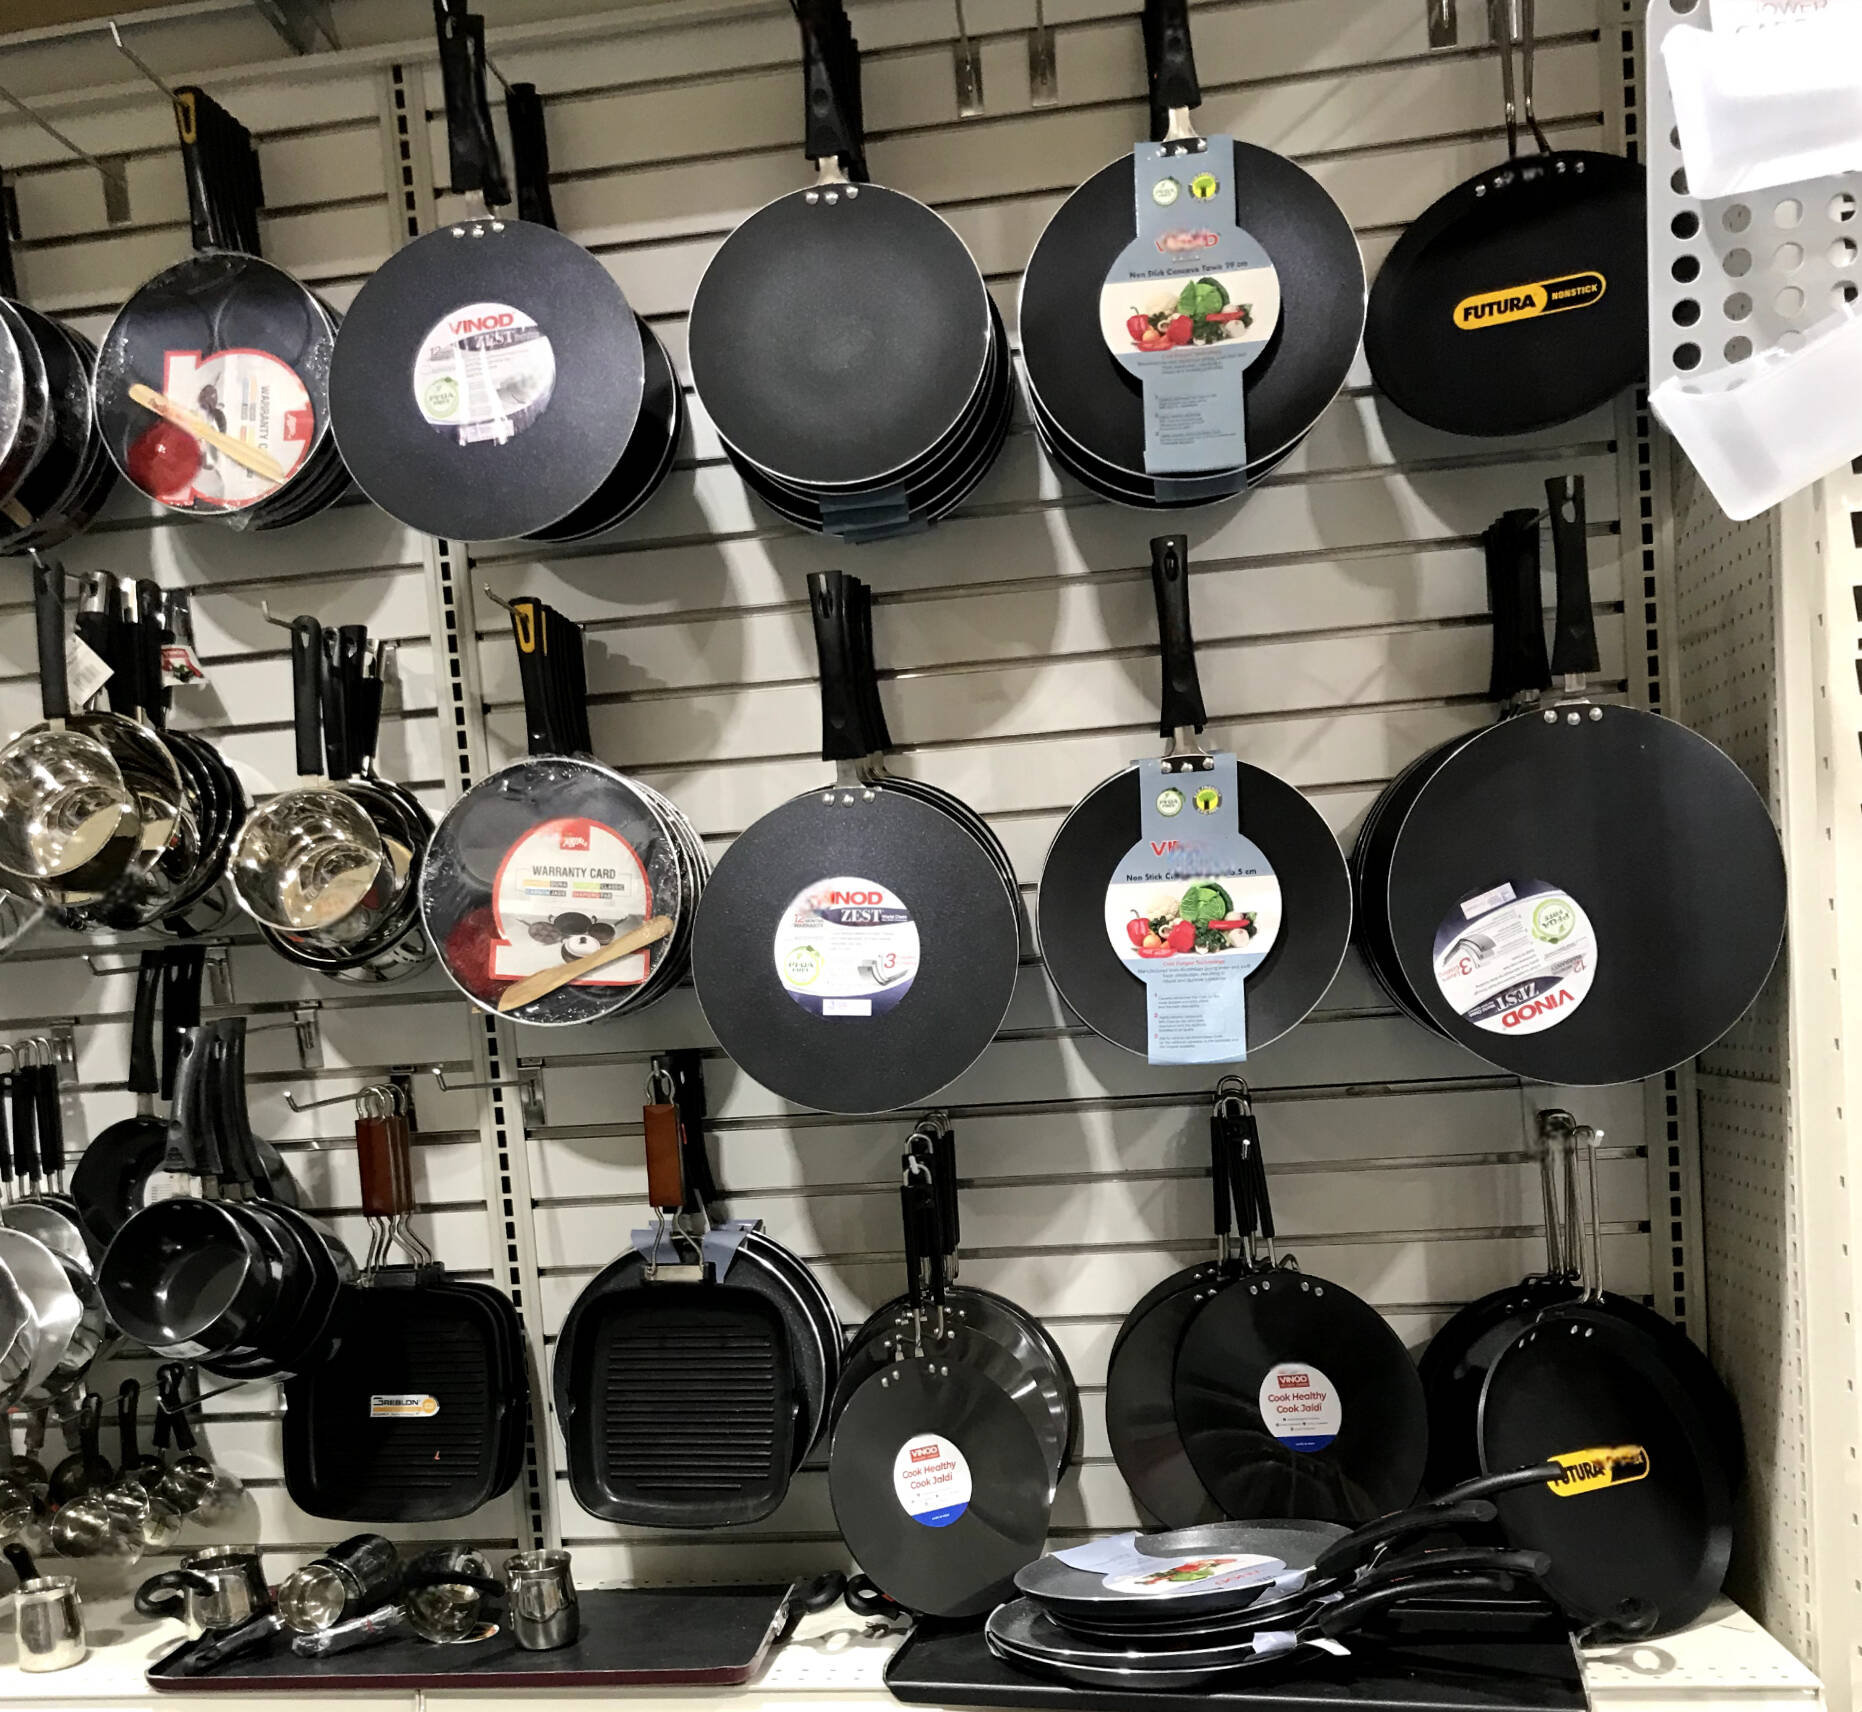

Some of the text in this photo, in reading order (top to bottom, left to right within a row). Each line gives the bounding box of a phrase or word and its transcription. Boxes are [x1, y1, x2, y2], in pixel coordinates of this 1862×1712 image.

[1463, 284, 1597, 322] FUTURA NONSTICK
[448, 313, 514, 335] VINOD
[259, 385, 270, 440] WARRANTY
[532, 866, 616, 879] WARRANTY CARD
[1145, 872, 1162, 880] Stick
[840, 908, 881, 923] ZEST
[884, 953, 897, 968] 3
[1459, 957, 1473, 975] 3
[1495, 981, 1540, 1012] ZEST
[1502, 989, 1575, 1028] VINOD
[1279, 1375, 1308, 1384] VINOD
[1268, 1391, 1327, 1402] Cook Healthy
[1276, 1403, 1322, 1414] Cook Jaldi
[902, 1460, 956, 1479] Cook Healthy
[910, 1472, 953, 1490] Cook Jaldi
